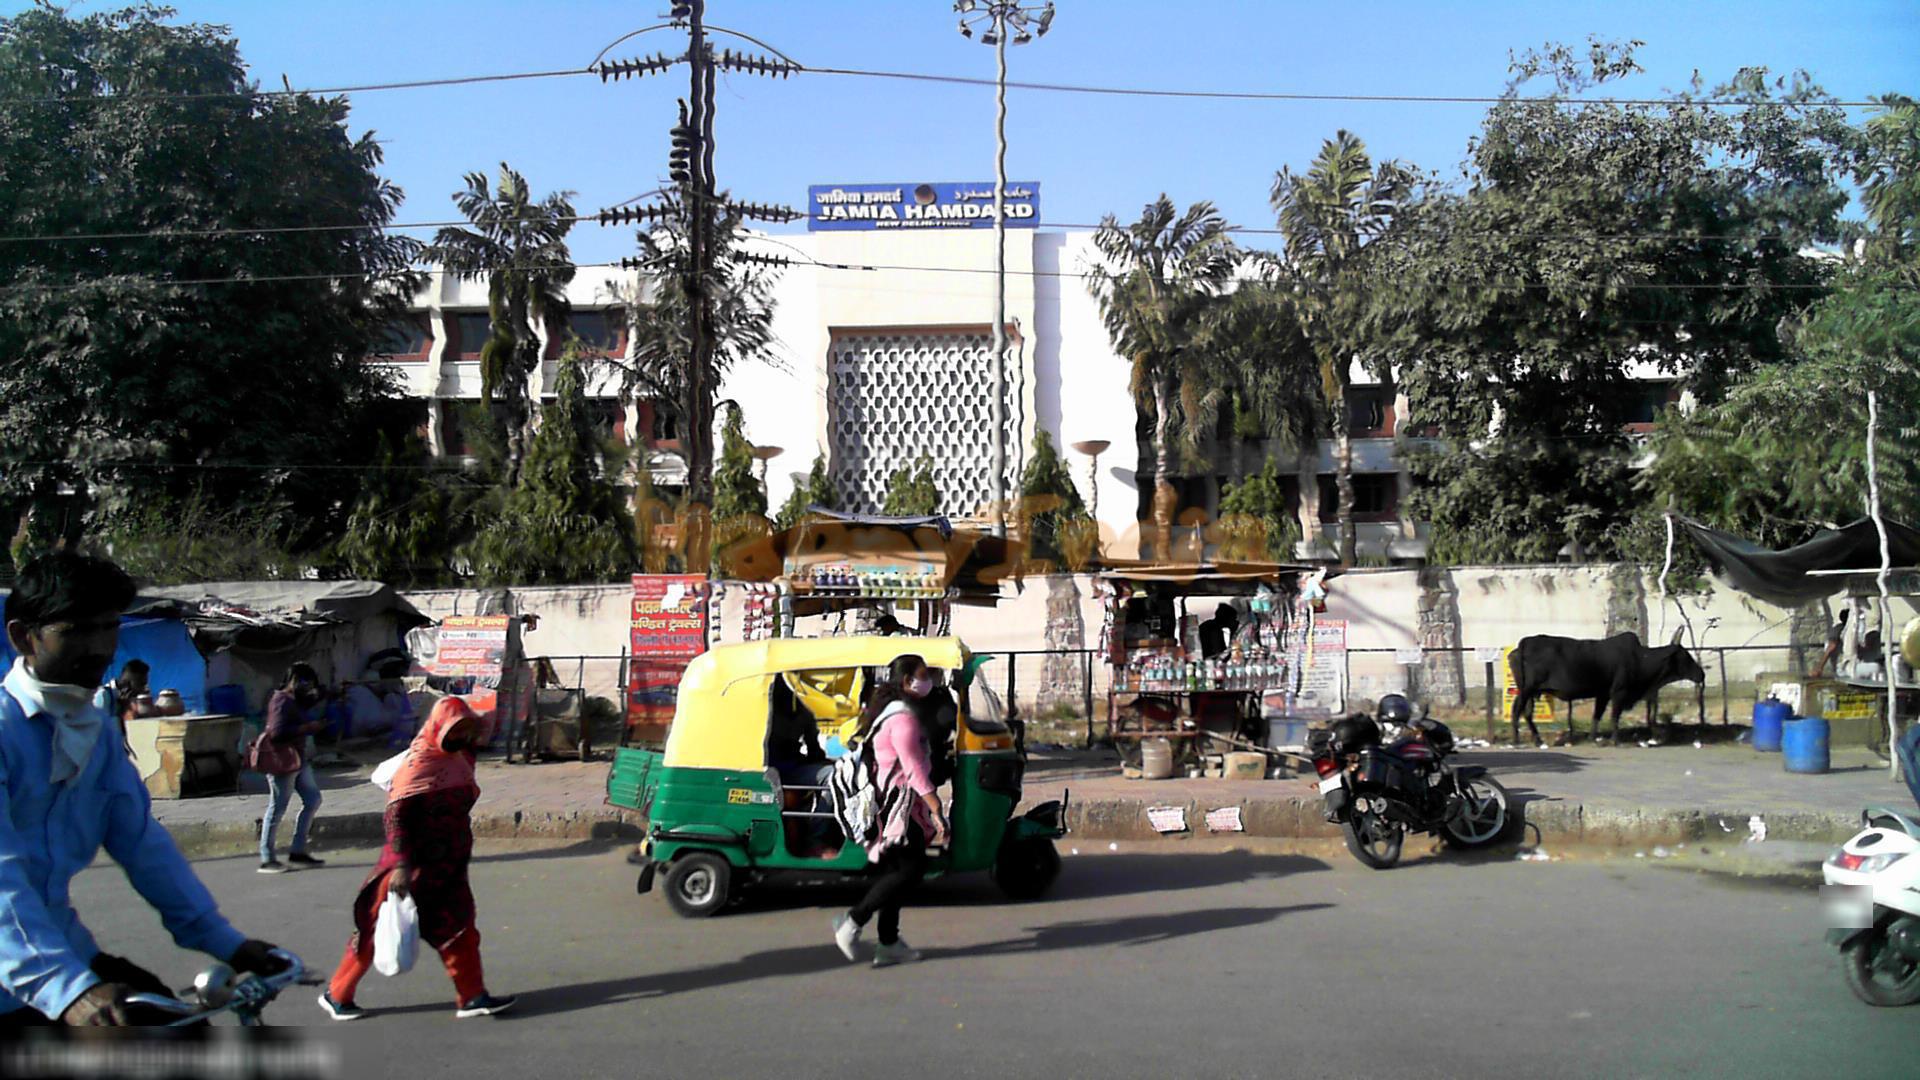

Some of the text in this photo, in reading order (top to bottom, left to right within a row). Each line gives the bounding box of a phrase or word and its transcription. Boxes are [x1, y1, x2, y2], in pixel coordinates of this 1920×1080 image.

[816, 203, 1034, 220] JAMIA HAMDARD
[876, 220, 899, 228] NEW
